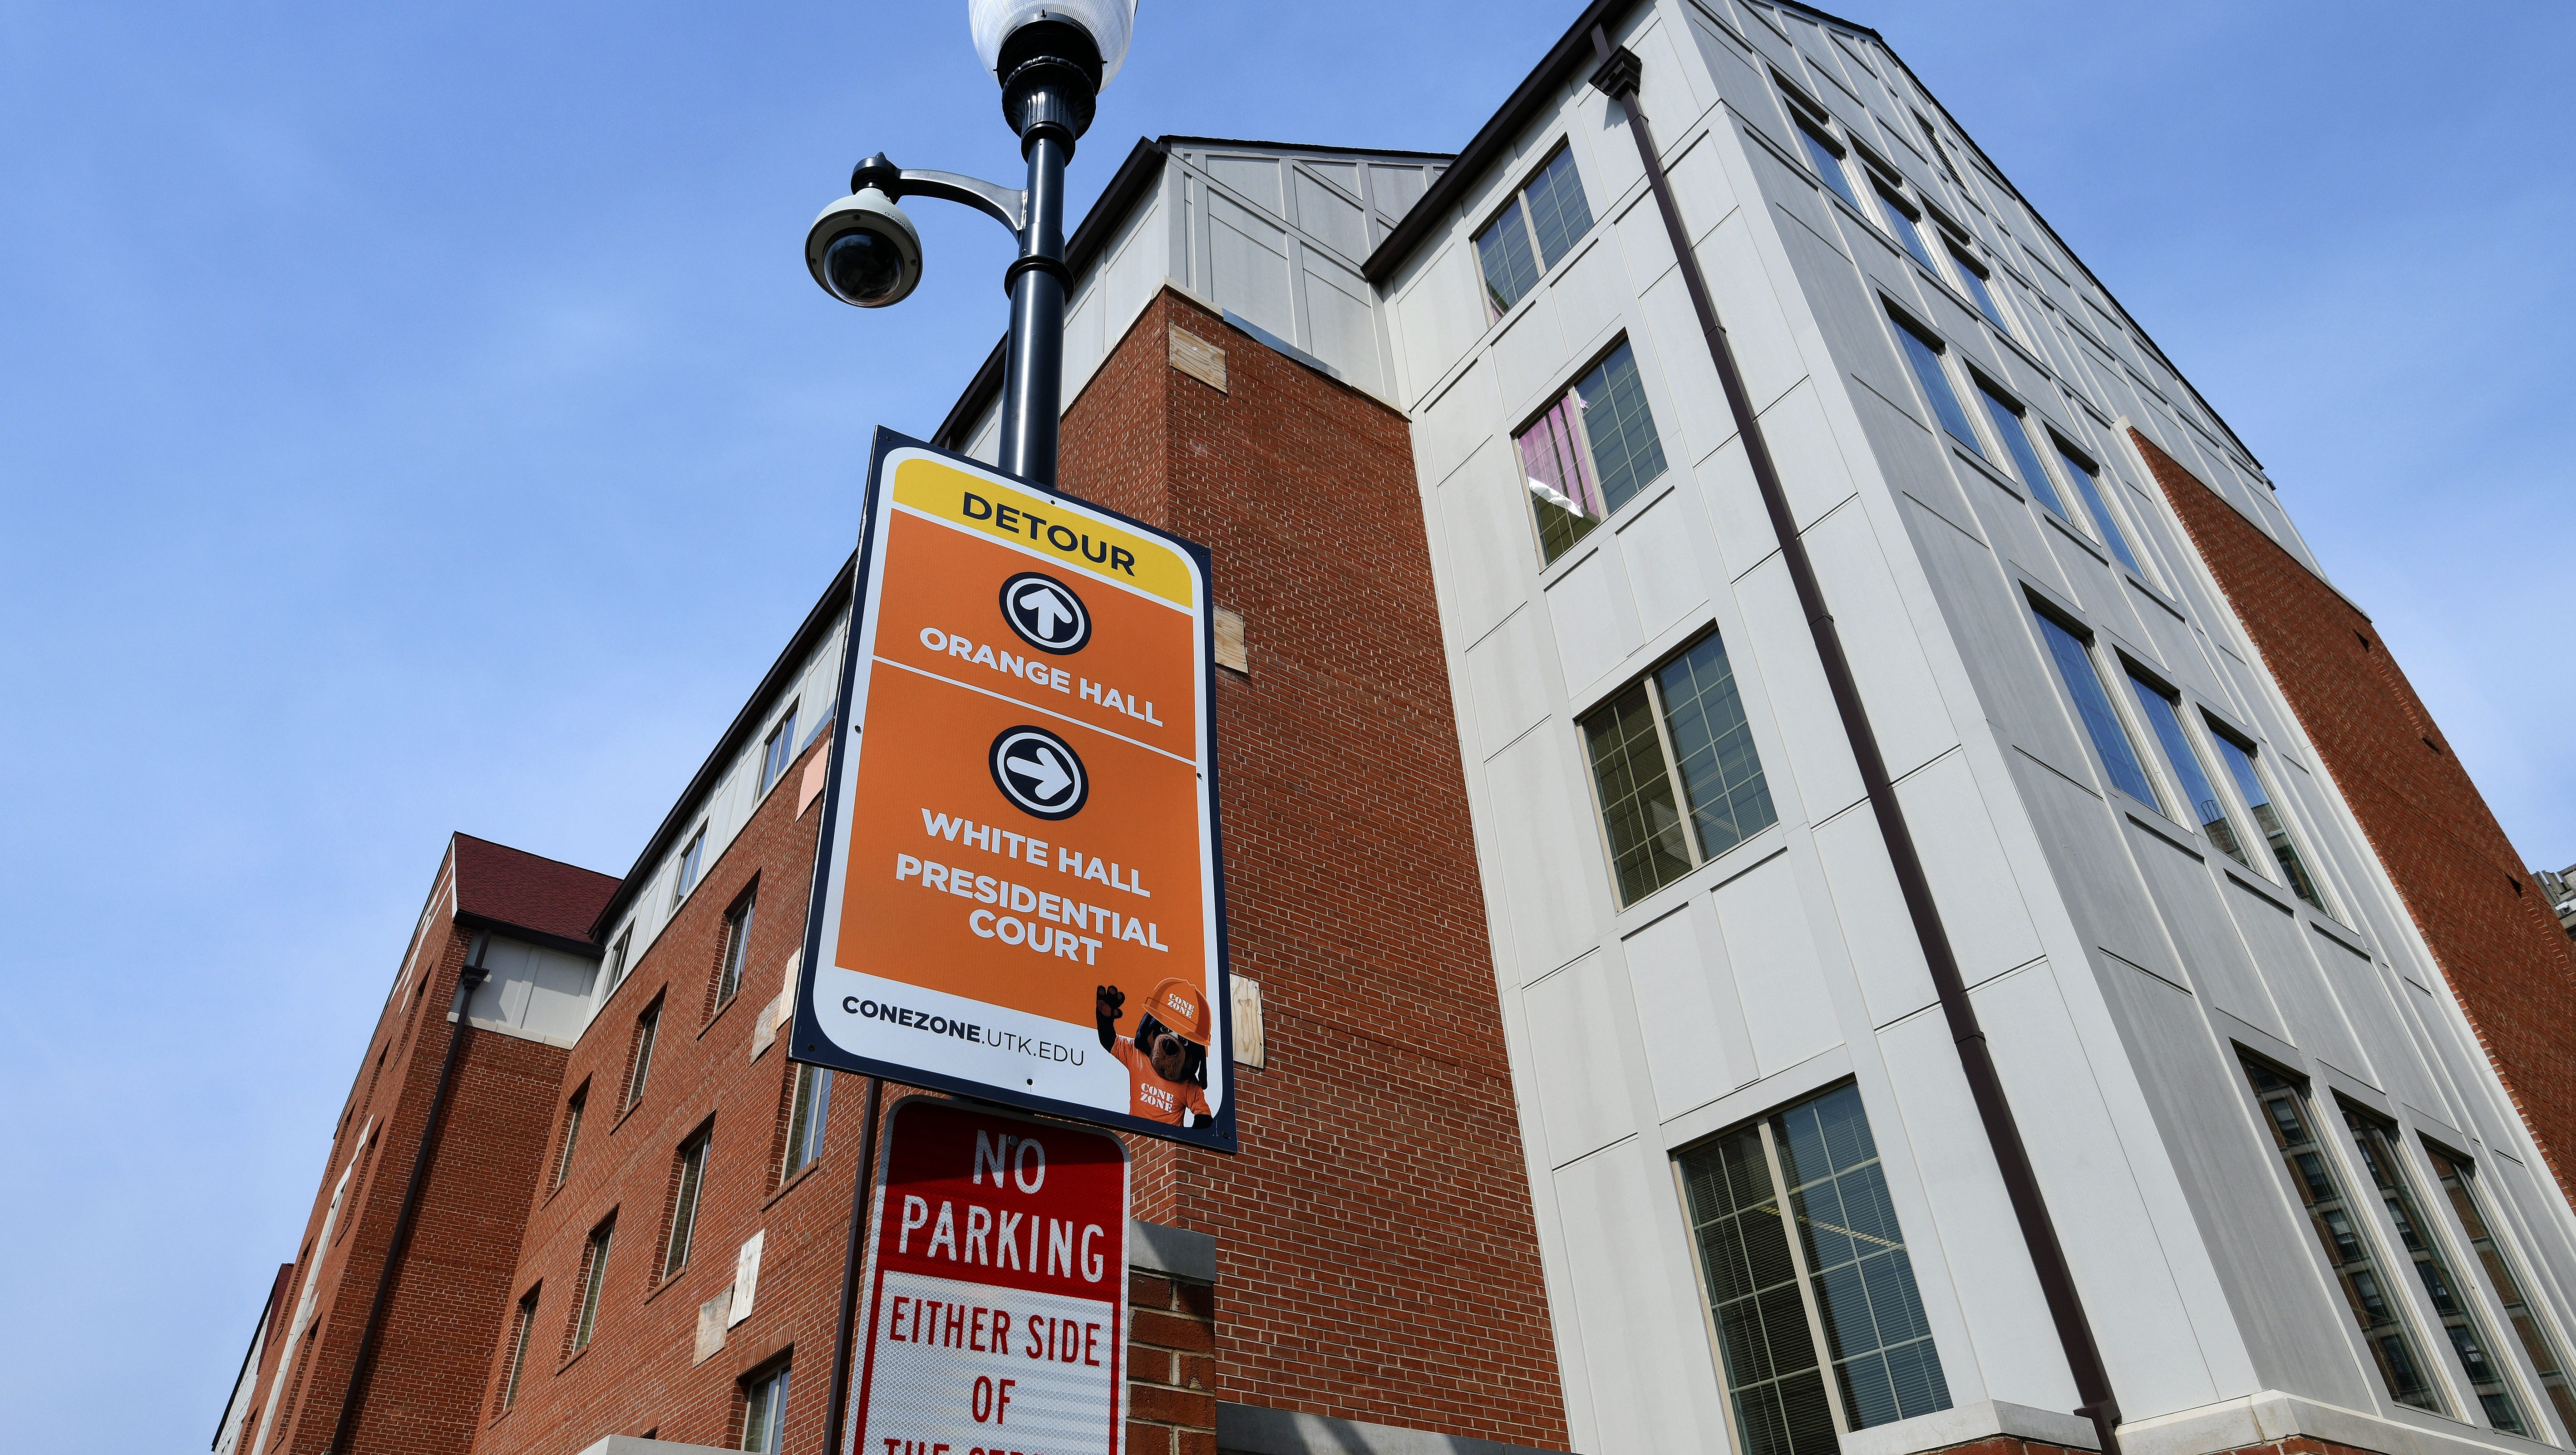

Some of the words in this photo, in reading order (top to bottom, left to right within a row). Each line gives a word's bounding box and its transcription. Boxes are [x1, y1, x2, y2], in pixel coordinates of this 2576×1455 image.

[962, 492, 1135, 577] DETOUR
[920, 627, 1071, 694] ORANGE
[1079, 677, 1163, 728] HALL
[921, 808, 1049, 868] WHITE
[1059, 847, 1150, 898] HALL
[896, 853, 1168, 953] PRESIDENTIAL
[969, 909, 1103, 965] COURT
[842, 996, 1084, 1067] CONEZONE.UTK.EDU
[1167, 998, 1192, 1018] ZONE
[1169, 993, 1194, 1012] CONE
[1140, 1092, 1172, 1113] ZONE
[1141, 1082, 1173, 1103] CONE
[973, 1129, 1045, 1194] NO
[899, 1194, 1104, 1283] PARKING
[890, 1296, 1011, 1354] EITHER
[1026, 1314, 1100, 1367] SIDE
[972, 1376, 1016, 1425] OF
